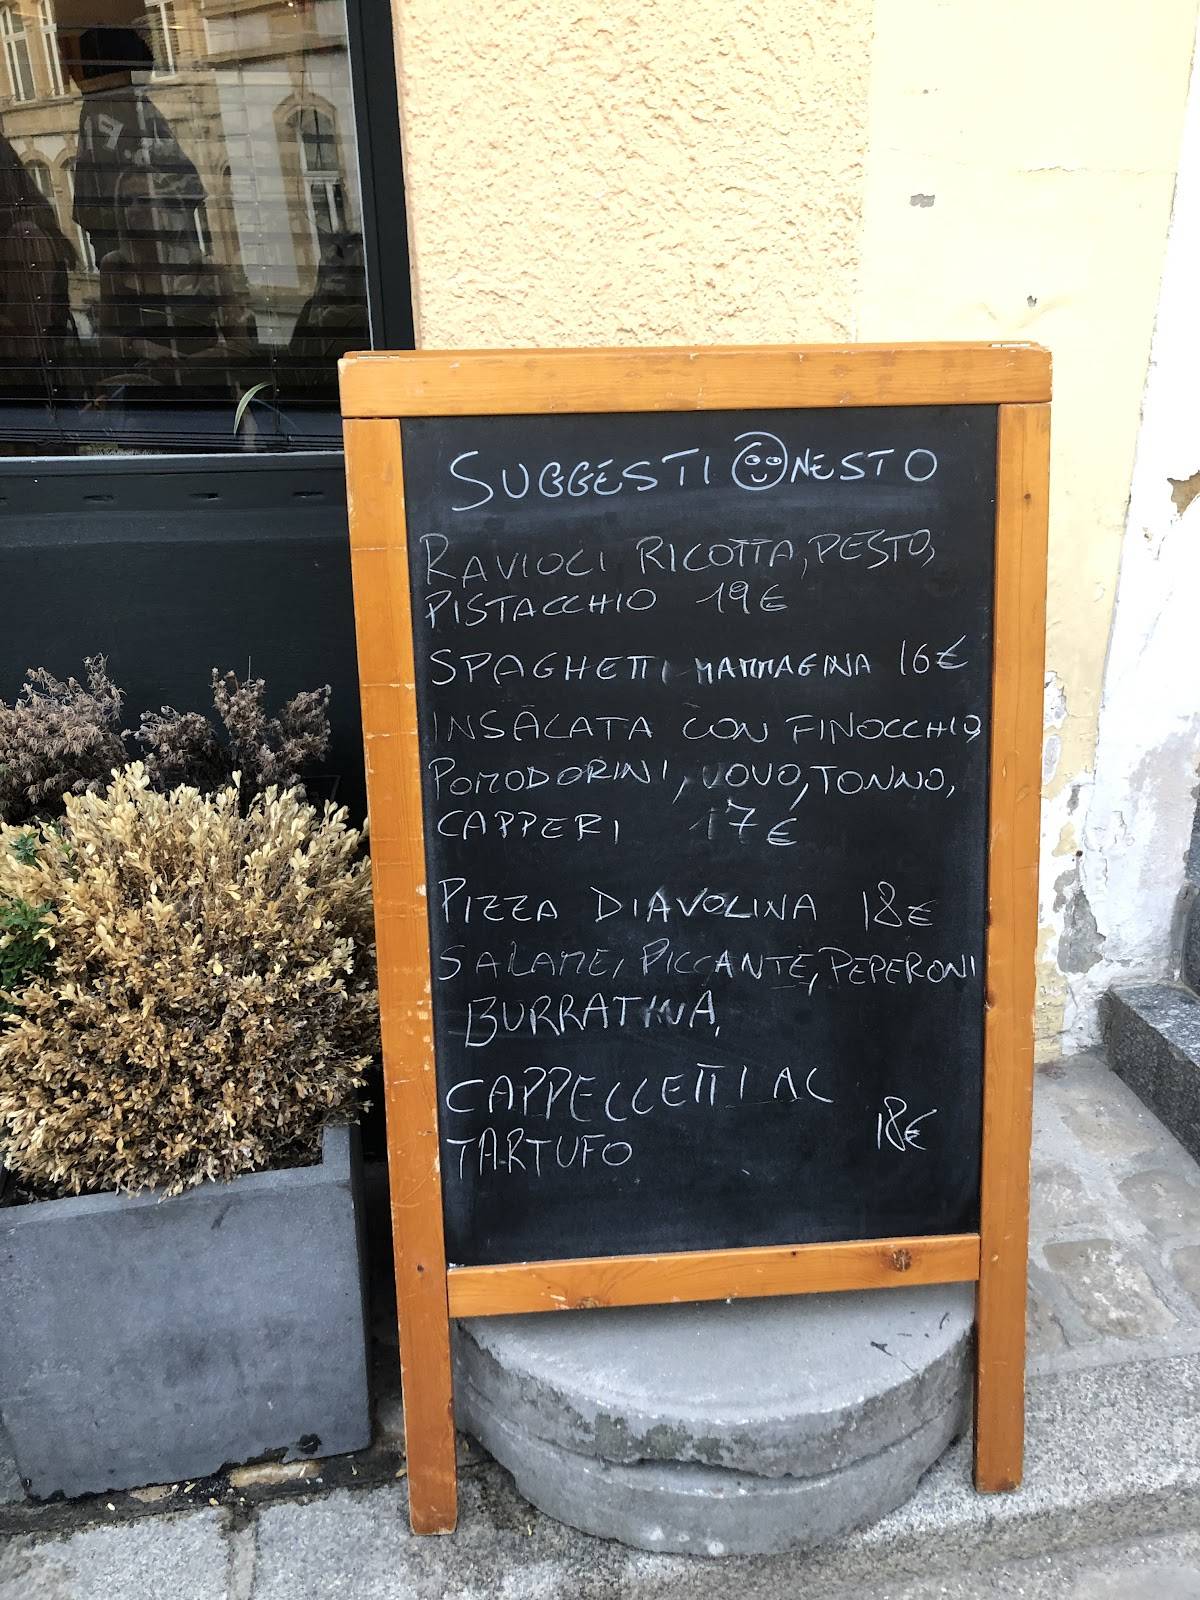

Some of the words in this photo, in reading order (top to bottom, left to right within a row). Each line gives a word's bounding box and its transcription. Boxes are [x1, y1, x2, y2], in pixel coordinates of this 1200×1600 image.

[424, 586, 658, 628] PISTACCHIO
[430, 648, 669, 686] SPAGHETTI
[900, 634, 969, 677] 16€
[682, 716, 769, 743] CON
[437, 809, 621, 843] CAPPERI
[438, 876, 559, 923] PIZZA
[590, 884, 818, 923] DIAVOLINA
[863, 880, 937, 930] 18€
[446, 1126, 634, 1179] TARTUFO
